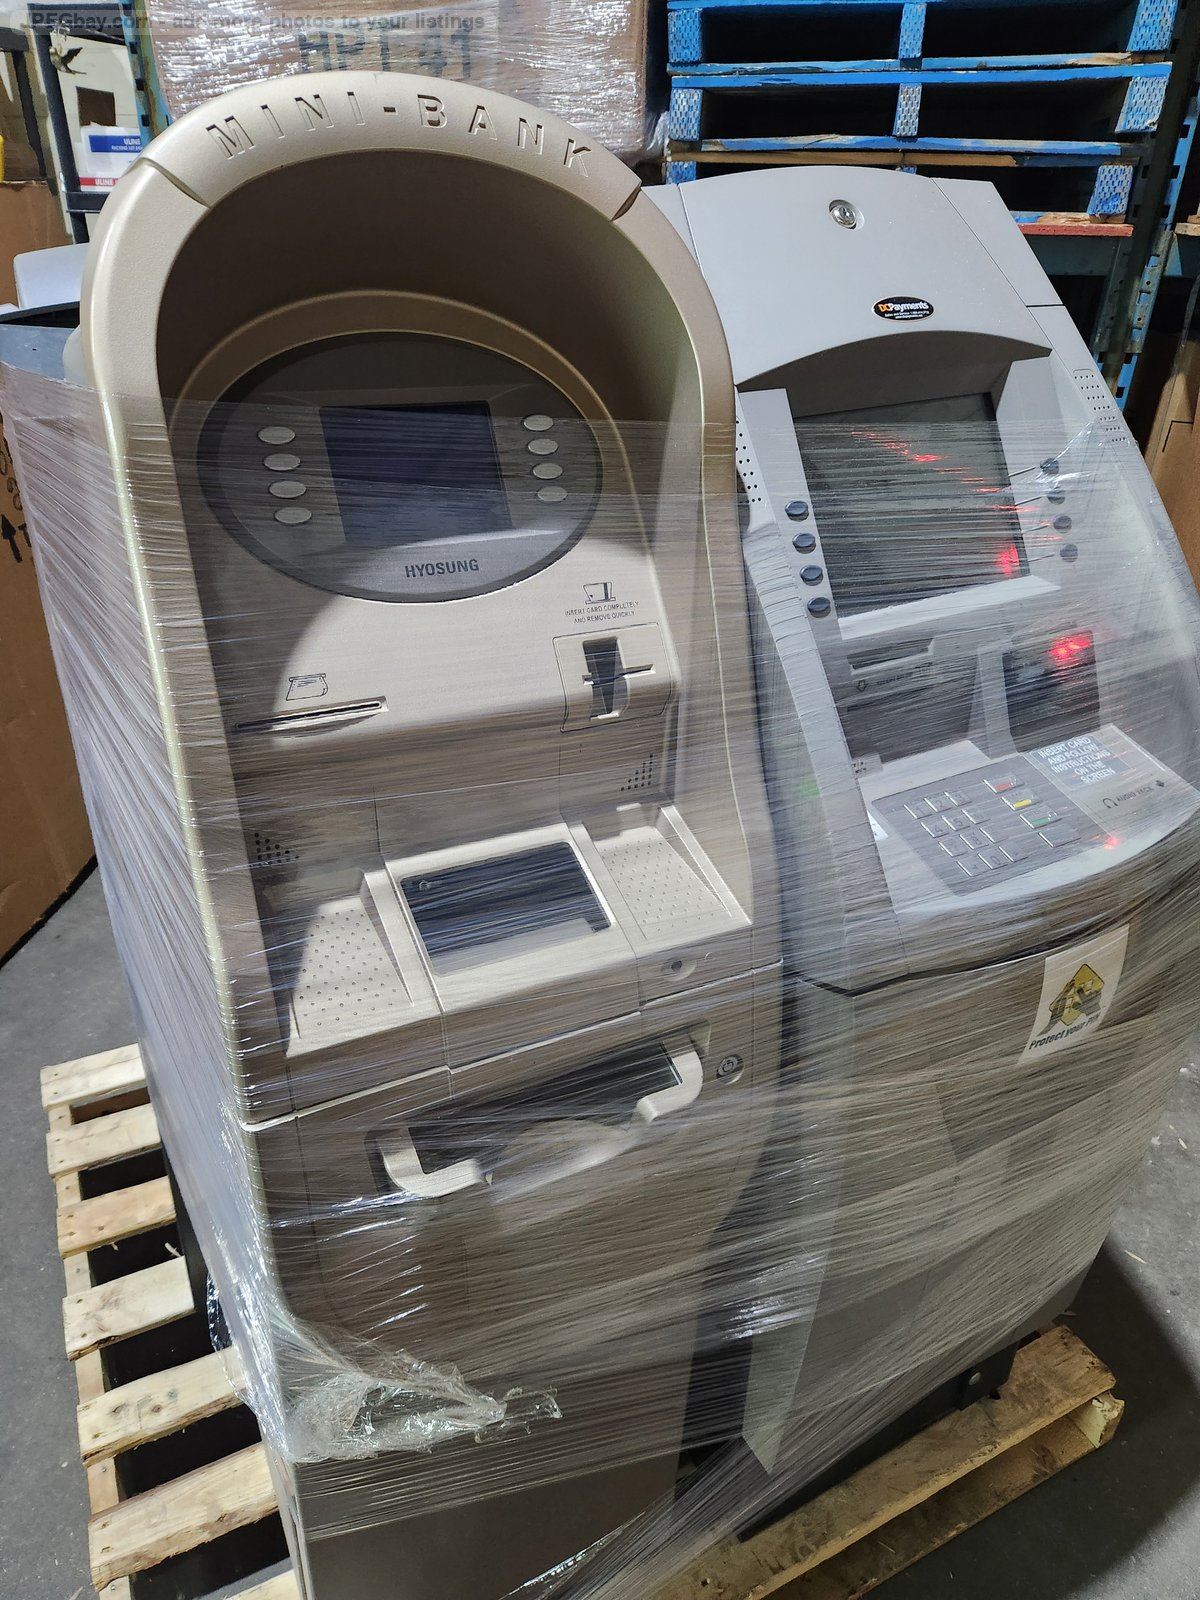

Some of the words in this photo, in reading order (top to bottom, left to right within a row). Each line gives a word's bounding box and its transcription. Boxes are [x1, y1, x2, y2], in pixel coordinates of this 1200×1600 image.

[206, 91, 592, 178] MINI-BANK
[405, 558, 480, 578] HYOSUNG
[565, 608, 585, 617] INSERT
[586, 605, 603, 614] CARD
[603, 601, 640, 612] COMPLETELY
[586, 613, 611, 622] REMOVE
[611, 610, 636, 619] QUICKLY
[1037, 742, 1069, 759] INSERT
[1068, 736, 1091, 750] CARD
[1047, 751, 1066, 766] AND
[1065, 742, 1101, 759] FOLLOW
[1073, 765, 1089, 776] ON
[1080, 767, 1117, 785] SCREEN
[1029, 1030, 1066, 1050] Protect
[1064, 1021, 1086, 1038] your
